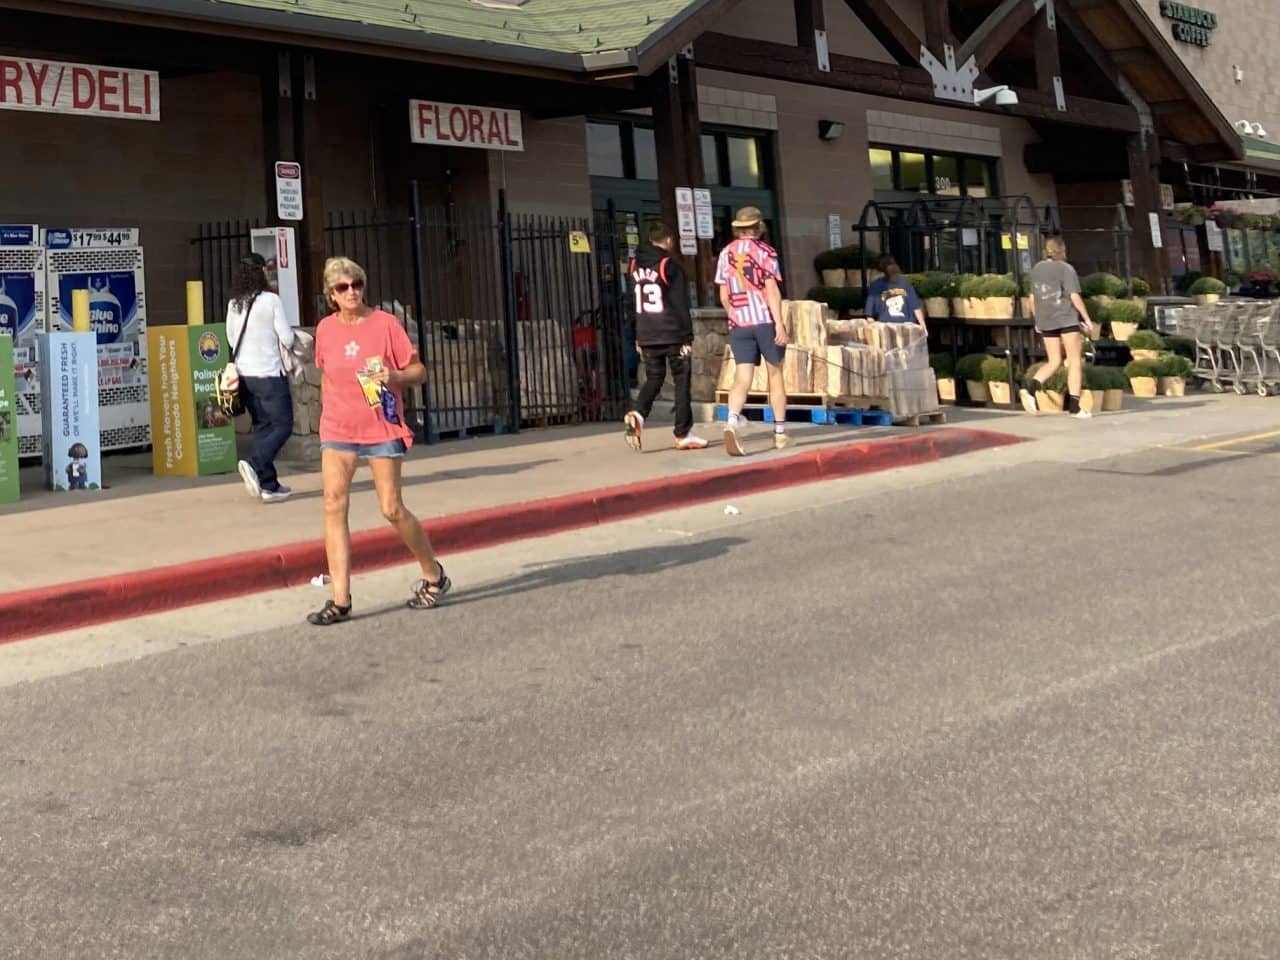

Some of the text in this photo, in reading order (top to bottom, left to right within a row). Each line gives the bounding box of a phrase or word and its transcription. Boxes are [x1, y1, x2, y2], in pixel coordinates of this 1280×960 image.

[418, 103, 520, 147] FLORAL
[634, 283, 664, 314] 13
[61, 342, 70, 437] GUARANTEED FRESH
[193, 368, 222, 380] Palisa
[163, 393, 171, 433] Flavors
[173, 403, 183, 460] Colorado
